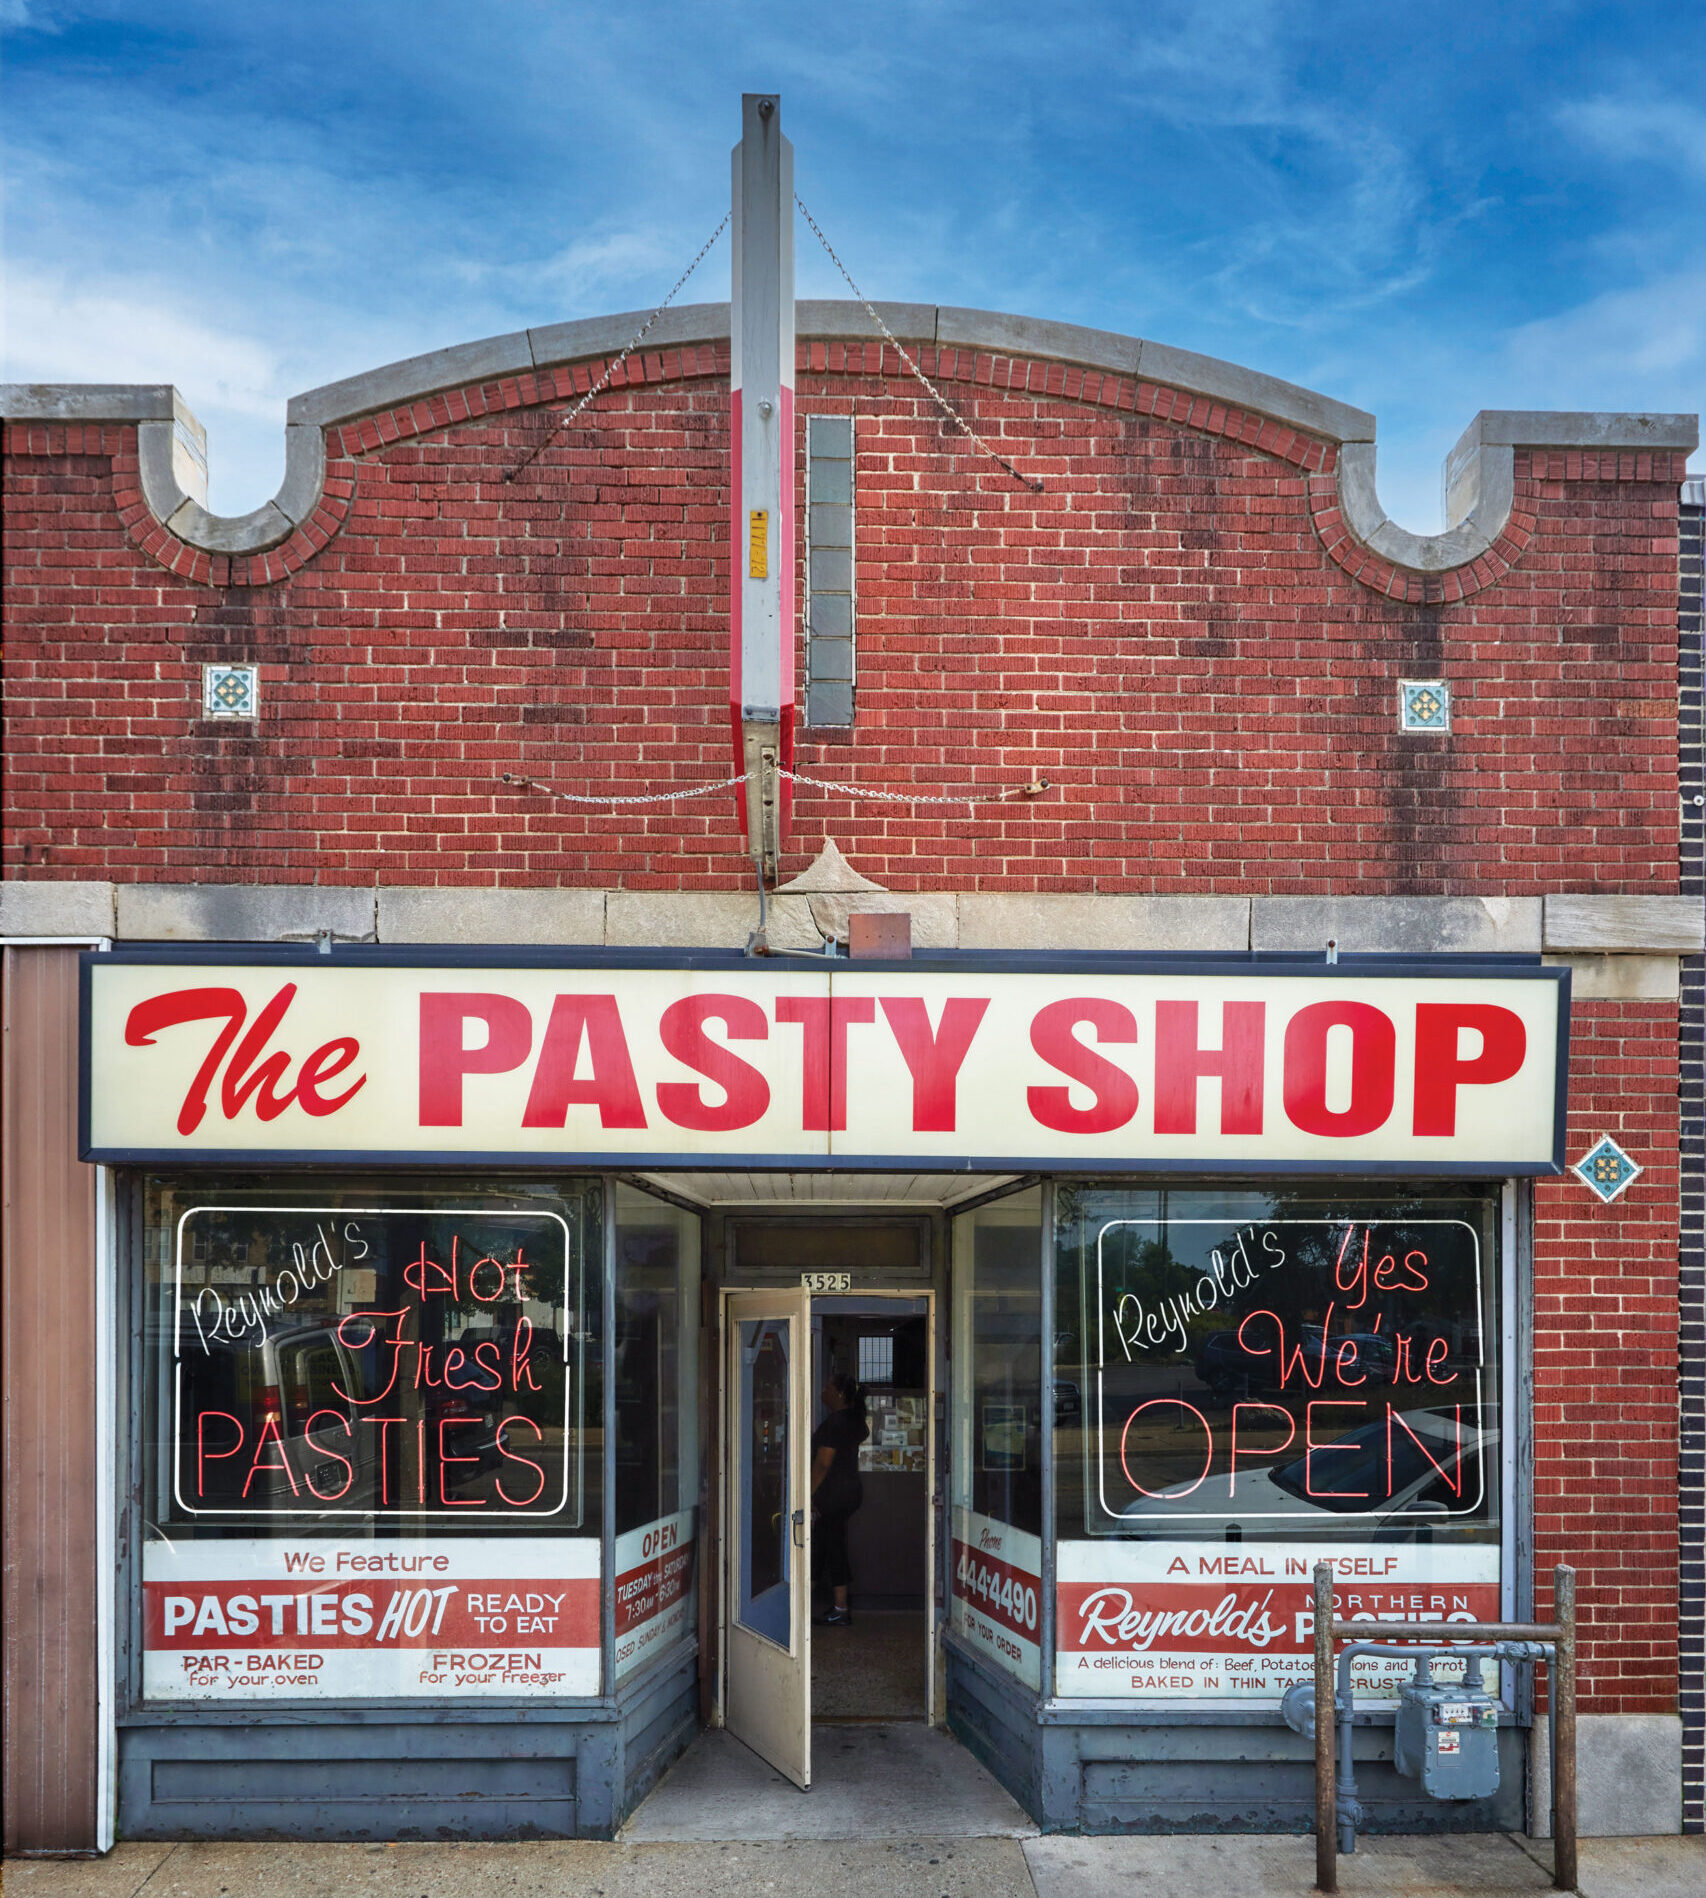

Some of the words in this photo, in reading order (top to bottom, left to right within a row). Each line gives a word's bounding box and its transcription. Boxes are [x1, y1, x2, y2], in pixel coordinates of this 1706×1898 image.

[125, 982, 366, 1136] The
[419, 992, 991, 1132] PASTY
[1026, 997, 1527, 1138] SHOP
[404, 1235, 530, 1302] Hot
[804, 1275, 849, 1290] 3525
[1335, 1224, 1428, 1308] Yes
[190, 1222, 368, 1356] Reynold's
[1113, 1227, 1285, 1362] Reynold's
[331, 1306, 543, 1405] Fresh
[1238, 1301, 1459, 1389] We're
[198, 1410, 545, 1505] PASTIES
[1120, 1398, 1461, 1499] OPEN
[642, 1521, 678, 1558] OPEN
[979, 1527, 1002, 1550] Phone
[284, 1551, 325, 1573] We
[337, 1551, 449, 1572] Feature
[1166, 1557, 1190, 1575] A
[1200, 1556, 1275, 1575] MEAL
[1285, 1557, 1307, 1575] IN
[1317, 1557, 1398, 1576] TSELF
[468, 1593, 566, 1613] READY
[617, 1571, 653, 1604] TUESDAY
[957, 1554, 1037, 1631] 444-4490
[164, 1592, 374, 1637] PASTIES
[376, 1585, 459, 1642] HOT
[474, 1616, 507, 1634] TO
[517, 1616, 559, 1634] EAT
[1078, 1588, 1287, 1651] Reynold's
[616, 1641, 636, 1663] OSED
[978, 1622, 994, 1645] YOUR
[996, 1635, 1022, 1664] ORDER
[183, 1654, 324, 1672] PAR-BAKED
[419, 1671, 449, 1685] for
[455, 1672, 497, 1688] your
[433, 1653, 542, 1671] FROZEN
[1077, 1656, 1090, 1669] A
[1094, 1656, 1154, 1670] delicious
[1159, 1657, 1195, 1670] blend
[1261, 1657, 1317, 1671] Potatoe
[1384, 1658, 1408, 1671] and
[1415, 1658, 1466, 1672] arrot
[189, 1671, 219, 1687] for
[227, 1674, 271, 1690] your
[275, 1673, 318, 1686] oven
[1131, 1675, 1194, 1688] BAKED
[1204, 1676, 1219, 1688] IN
[1230, 1677, 1266, 1689] THIN
